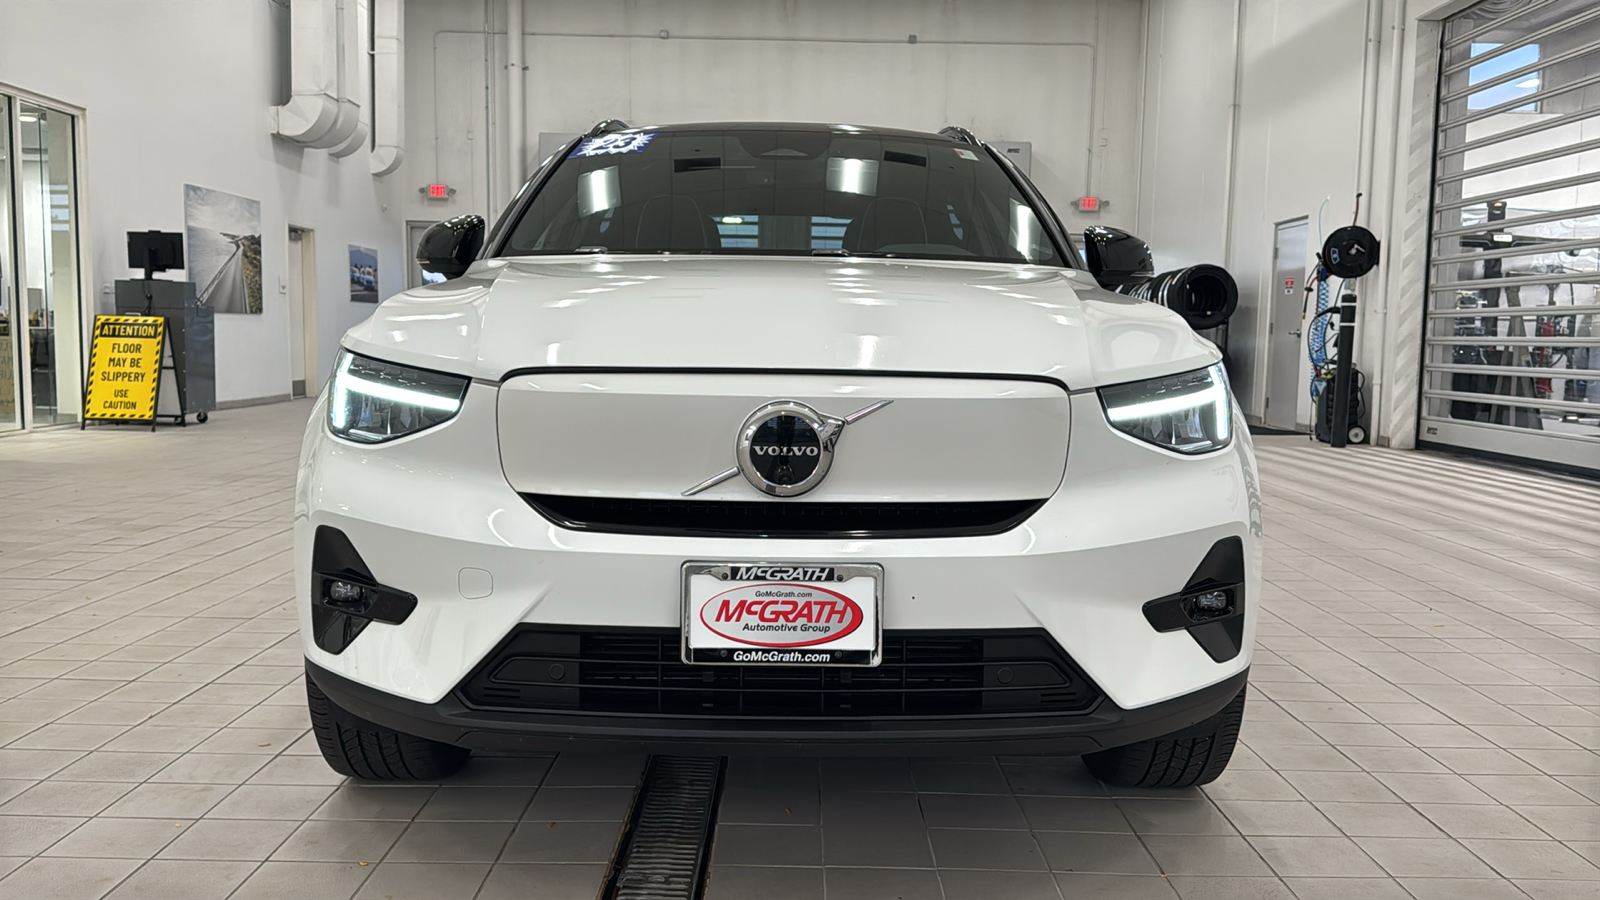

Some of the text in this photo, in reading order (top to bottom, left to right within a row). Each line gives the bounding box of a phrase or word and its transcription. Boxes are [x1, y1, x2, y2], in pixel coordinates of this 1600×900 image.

[591, 137, 637, 151] 23
[430, 185, 445, 197] EXIT
[1082, 197, 1097, 209] EXIT
[102, 324, 155, 336] ATTENTION
[112, 343, 142, 353] FLOOR
[108, 357, 142, 368] MAY BE
[101, 371, 146, 382] SLIPPERY
[114, 389, 129, 398] USE
[103, 400, 137, 410] CAUTION
[752, 445, 818, 456] VOLVO
[755, 590, 813, 598] GoMcGrath.com
[742, 623, 831, 634] Automotive Group
[733, 650, 831, 663] GoMcGrath.com
